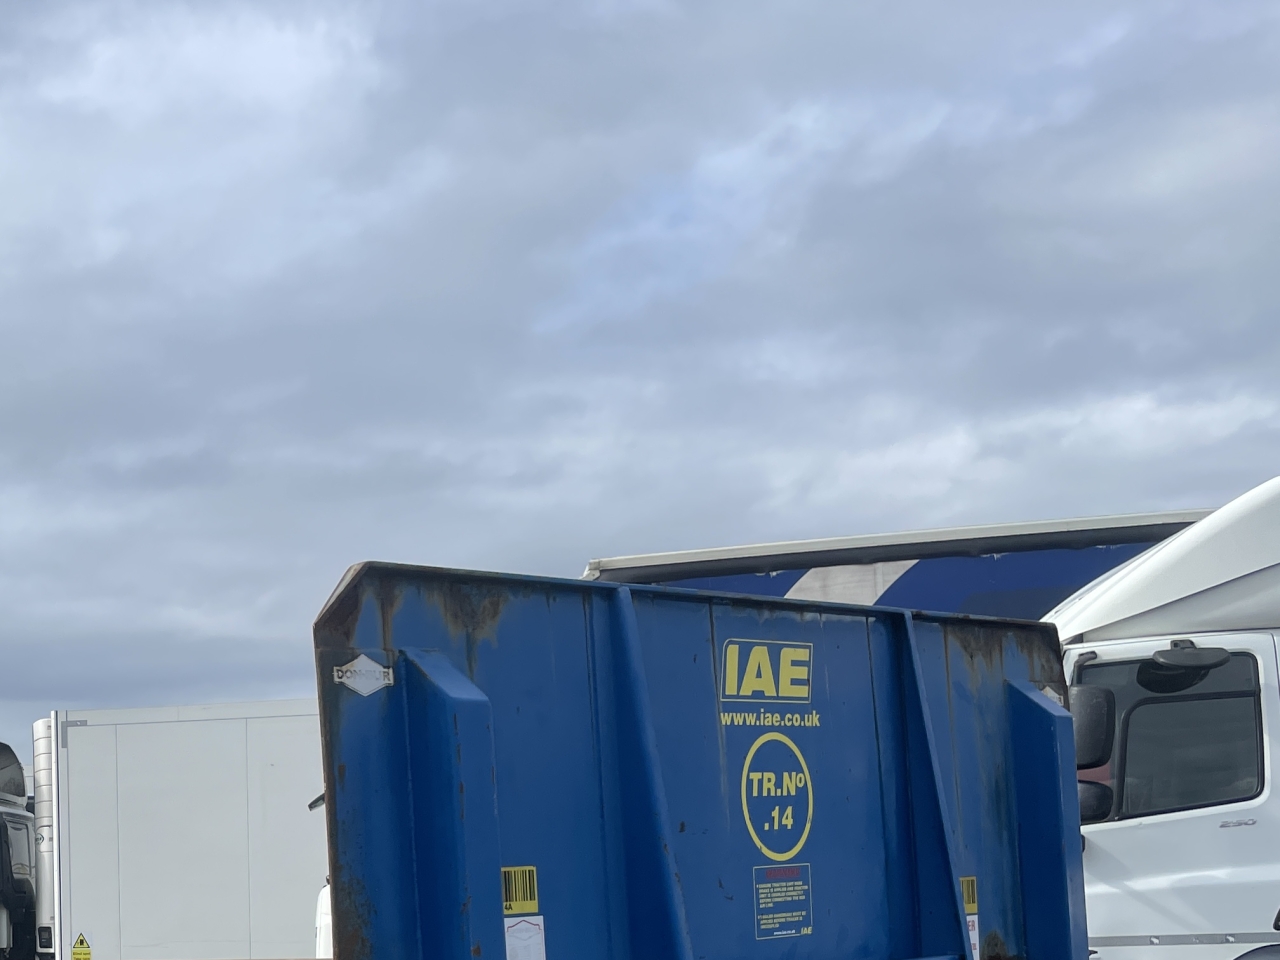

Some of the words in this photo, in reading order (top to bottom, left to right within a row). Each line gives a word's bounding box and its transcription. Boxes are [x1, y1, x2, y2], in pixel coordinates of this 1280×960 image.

[724, 644, 810, 698] IAE
[720, 708, 820, 727] www.iae.co.uk
[1219, 818, 1257, 828] 250
